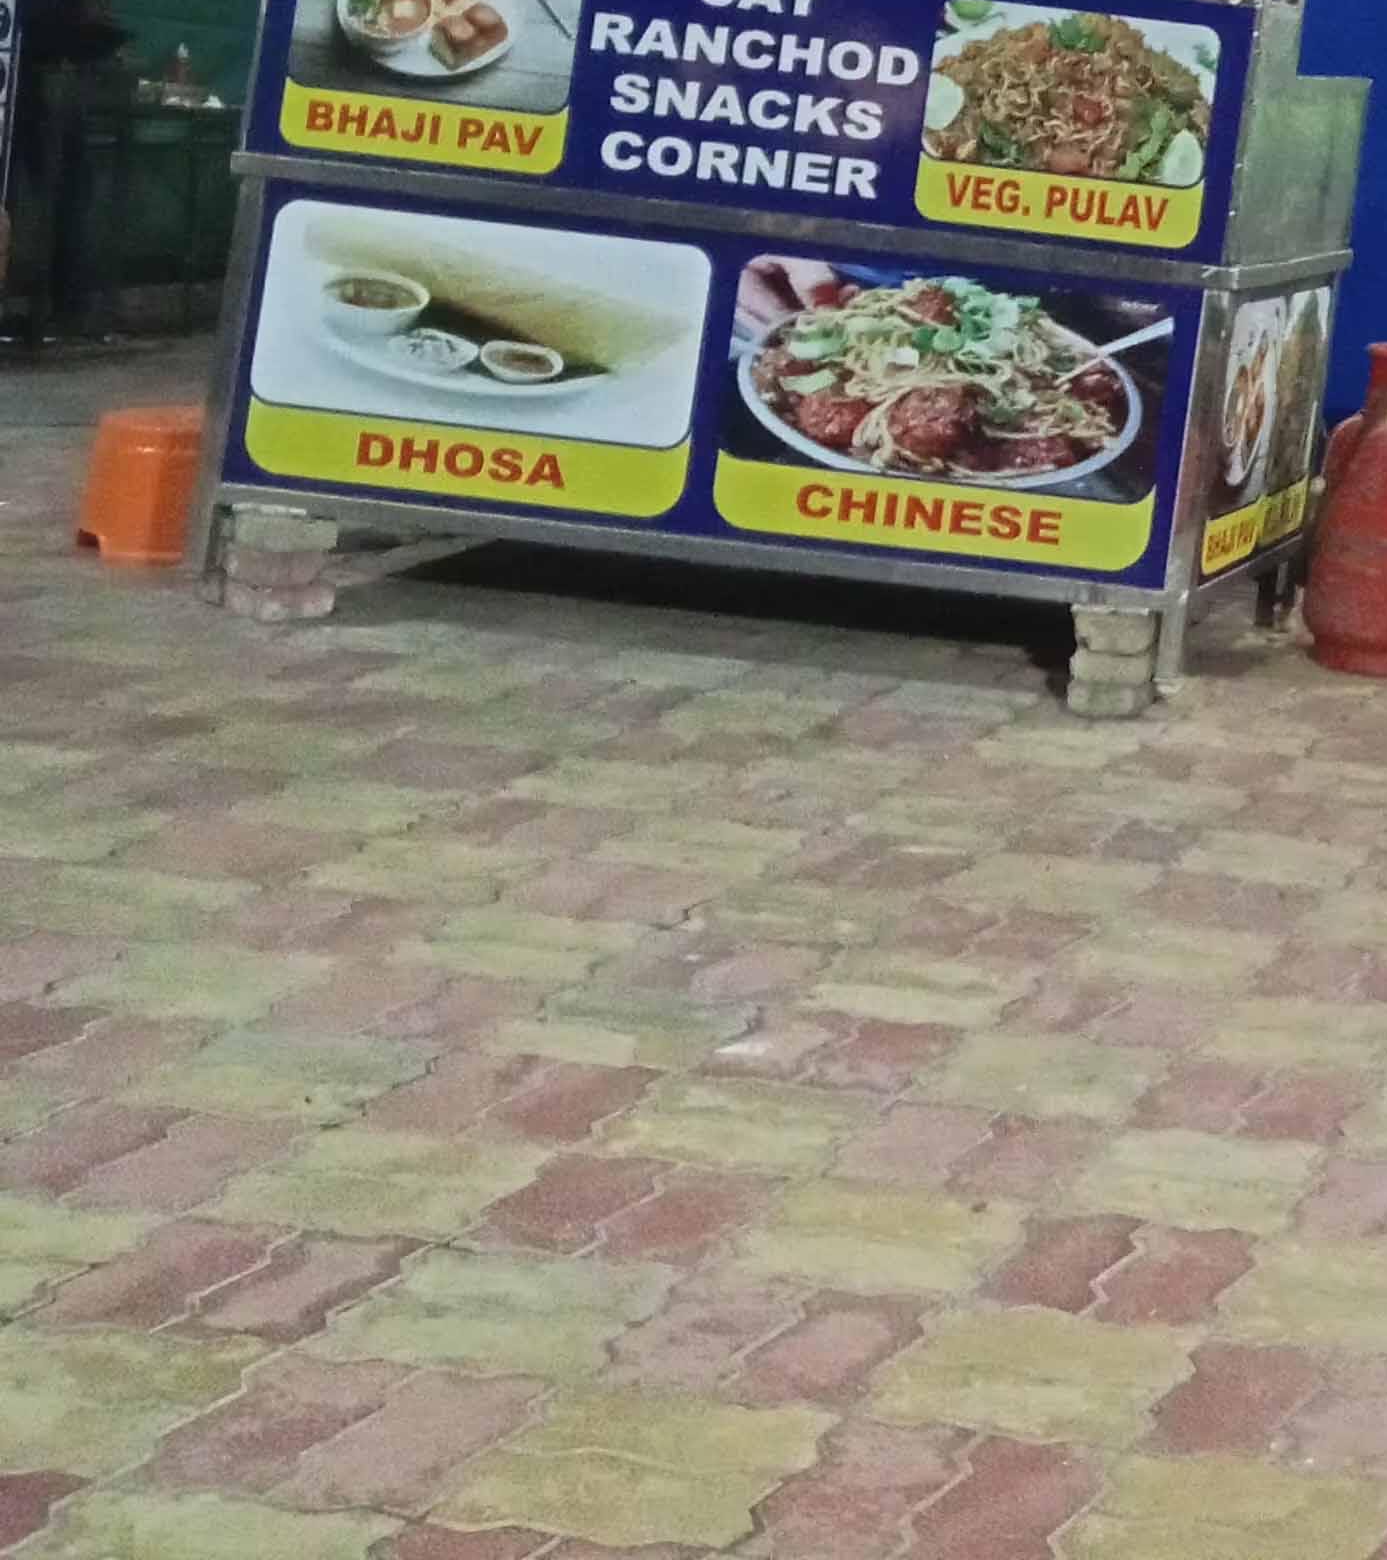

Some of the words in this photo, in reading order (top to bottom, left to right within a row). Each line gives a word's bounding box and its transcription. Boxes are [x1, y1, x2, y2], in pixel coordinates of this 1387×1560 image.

[590, 12, 920, 86] RANCHOD
[305, 100, 441, 146] BHAJI
[456, 119, 544, 157] PAV
[610, 73, 884, 140] SNACKS
[601, 131, 881, 200] CORNER
[946, 172, 1031, 217] VEG.
[1045, 186, 1169, 232] PULAV
[356, 431, 566, 491] DHOSA
[796, 483, 1063, 547] CHINESE
